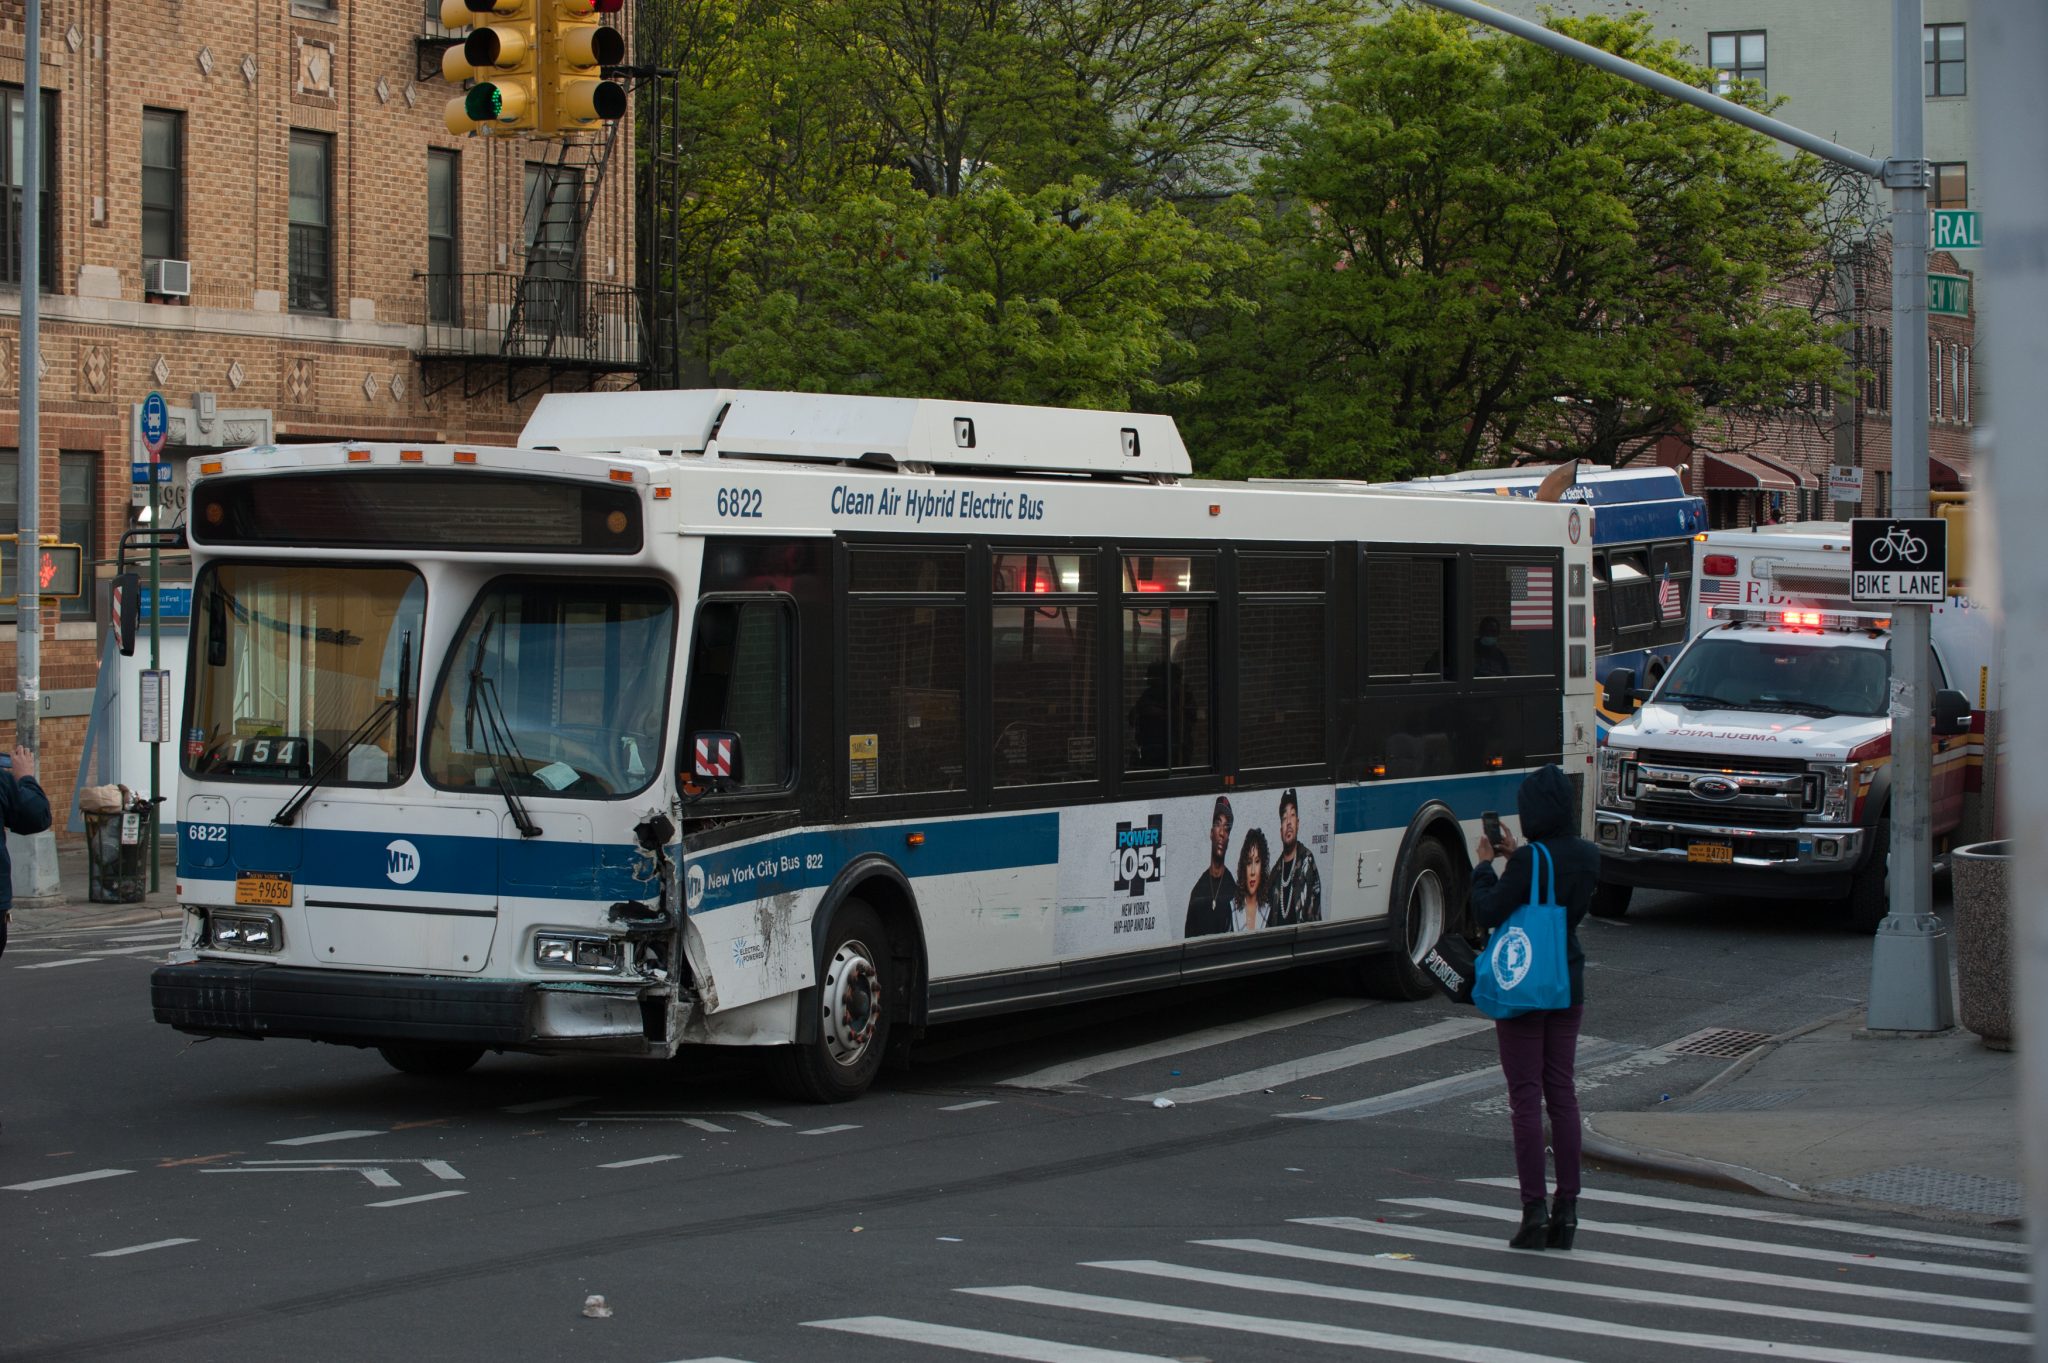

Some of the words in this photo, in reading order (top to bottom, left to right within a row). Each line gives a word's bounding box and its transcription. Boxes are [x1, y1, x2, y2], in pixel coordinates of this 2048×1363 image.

[717, 487, 763, 518] 6822
[831, 485, 874, 515] Clean
[877, 487, 901, 516] Air
[905, 489, 956, 524] Hybrid
[959, 490, 1014, 520] Electric
[1018, 493, 1045, 521] Bus
[1856, 575, 1891, 594] BIKE
[1899, 575, 1941, 595] LANE
[231, 739, 295, 764] 154
[189, 825, 227, 842] 6822
[1119, 828, 1159, 847] POWER
[386, 849, 415, 874] MTA
[1109, 843, 1167, 881] 105.1
[708, 873, 731, 890] New
[732, 864, 756, 884] York
[757, 860, 778, 878] City
[780, 855, 800, 872] Bus
[265, 882, 288, 900] 9656
[1121, 902, 1132, 917] NEW
[1133, 901, 1150, 915] YORK'S
[1113, 919, 1134, 935] HIP-HOP
[1134, 918, 1144, 932] AND
[1144, 916, 1155, 931] R&B
[739, 944, 761, 956] ELECTRIC
[742, 951, 765, 962] POWERED
[1424, 947, 1465, 993] PINK
